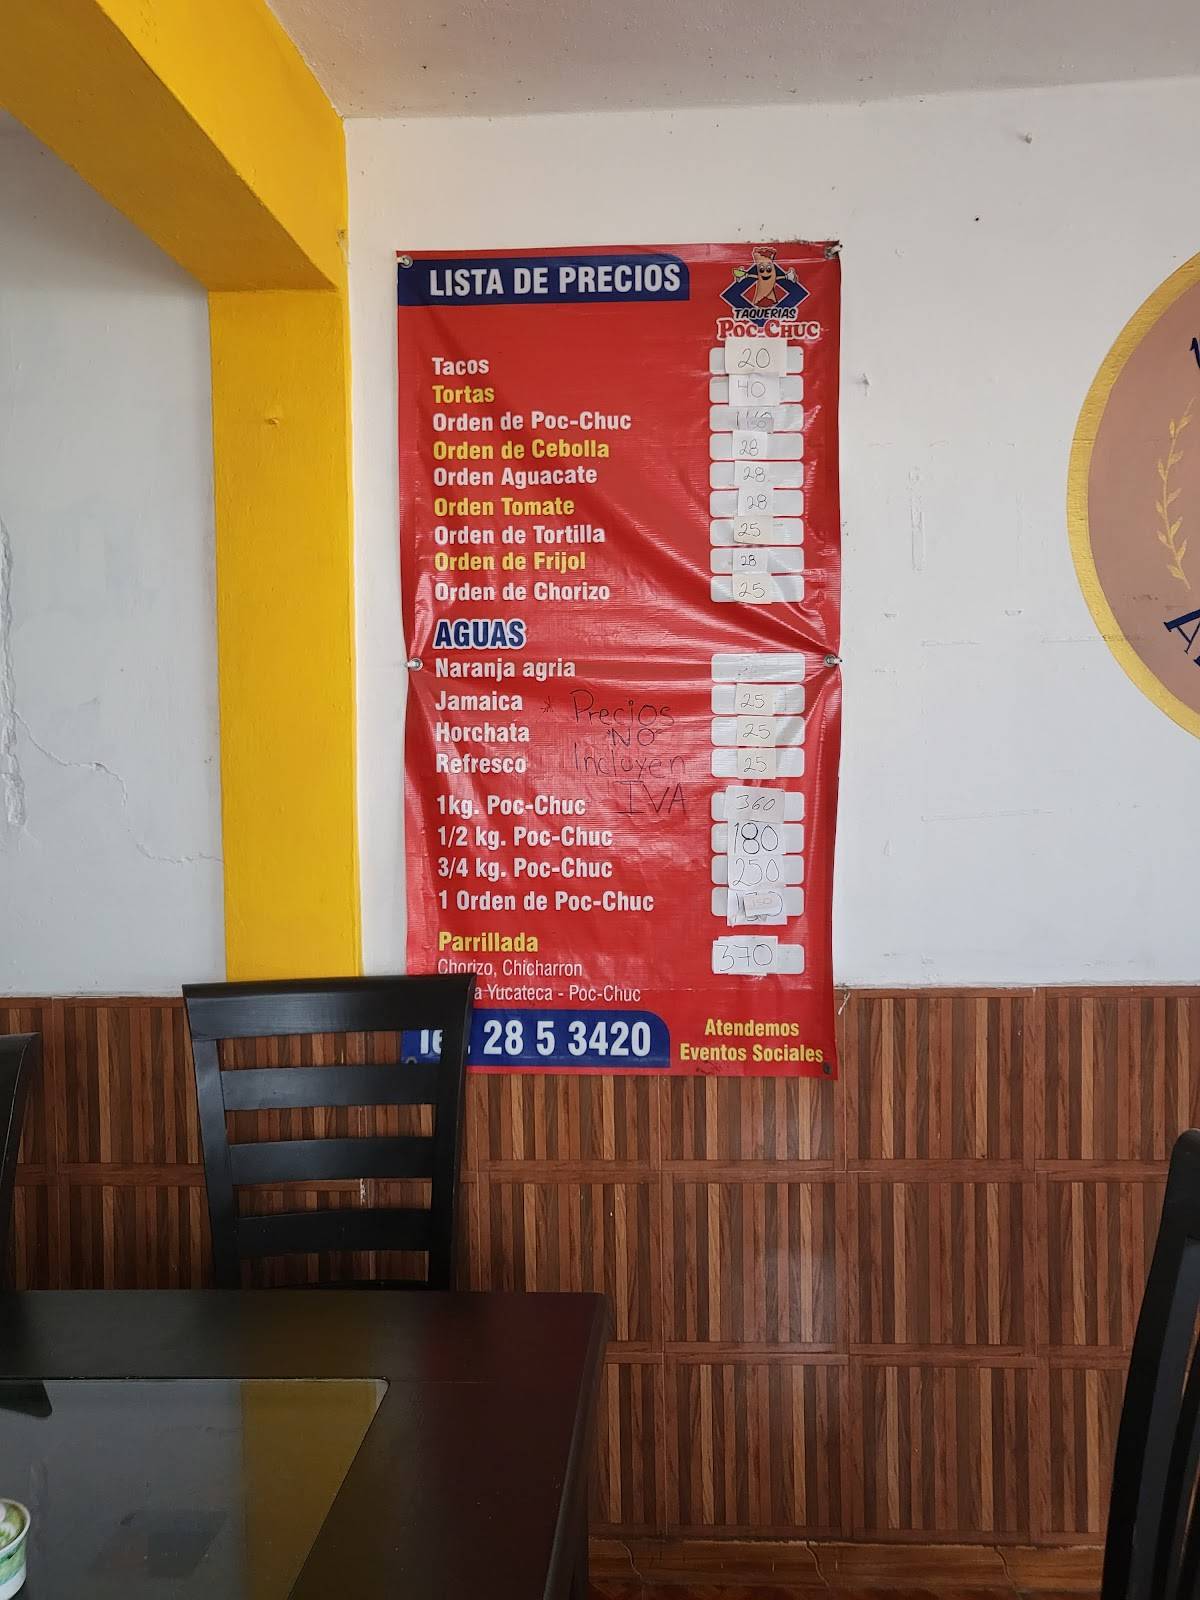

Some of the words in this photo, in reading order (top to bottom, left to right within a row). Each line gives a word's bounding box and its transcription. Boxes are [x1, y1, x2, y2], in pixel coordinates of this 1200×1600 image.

[430, 268, 504, 296] LISTA
[514, 267, 548, 295] DE
[559, 263, 681, 293] PRECIOS
[734, 308, 797, 319] TAQUERIAS
[432, 356, 490, 375] Tacos
[737, 348, 770, 368] 20
[432, 385, 494, 404] Tortas
[737, 379, 766, 398] 40
[432, 413, 493, 431] Orden
[500, 411, 524, 430] de
[531, 410, 632, 430] Poc-Chuc
[433, 441, 494, 460] Orden
[501, 441, 525, 459] de
[532, 439, 609, 458] Cebolla
[740, 439, 759, 456] 28
[433, 467, 494, 486] Orden
[501, 465, 598, 490] Aguacate
[743, 466, 765, 482] 28
[434, 497, 494, 516] Orden
[501, 496, 575, 515] Tomate
[747, 494, 767, 510] 28
[434, 525, 494, 545] Orden
[501, 525, 526, 544] de
[533, 524, 606, 544] Tortilla
[738, 522, 761, 537] 25
[434, 552, 495, 572] Orden
[502, 552, 526, 571] de
[534, 551, 586, 574] Frijol
[741, 555, 756, 567] 28
[435, 582, 495, 601] Orden
[502, 582, 527, 601] de
[533, 581, 610, 601] Chorizo
[739, 583, 765, 598] 25
[434, 619, 526, 648] AGUAS
[435, 657, 516, 681] Naranja
[522, 658, 576, 681] agria
[435, 690, 523, 711] Jamaica
[569, 689, 675, 727] Precios
[741, 693, 765, 709] 25
[435, 722, 530, 743] Horchata
[743, 723, 771, 739] 25
[436, 753, 528, 774] Refresco
[574, 743, 686, 779] Incluyen
[744, 756, 767, 773] 25
[437, 795, 480, 820] 1kg.
[487, 794, 586, 815] Poc-Chuc
[613, 780, 687, 815] IVA
[736, 794, 776, 811] 360
[438, 826, 468, 848] 1/2
[475, 826, 506, 850] kg.
[514, 825, 613, 846] Poc-Chuc
[734, 822, 779, 854] 180
[438, 857, 468, 879] 3/4
[475, 857, 506, 882] kg.
[514, 857, 613, 878] Poc-Chuc
[732, 857, 780, 886] 250
[438, 890, 448, 909] 1
[456, 890, 516, 911] Orden
[523, 891, 548, 911] de
[555, 891, 654, 912] Poc-Chuc
[438, 931, 539, 953] Parrillada
[502, 958, 583, 977] Chicharron
[714, 943, 773, 972] 370
[487, 983, 553, 1001] Yucateca
[569, 985, 641, 1001] Poc-Chuc
[483, 1019, 524, 1056] 28
[536, 1020, 555, 1056] 5
[567, 1020, 651, 1056] 3420
[704, 1018, 800, 1037] Atendemos
[680, 1043, 747, 1061] Eventos
[752, 1044, 824, 1063] Sociales
